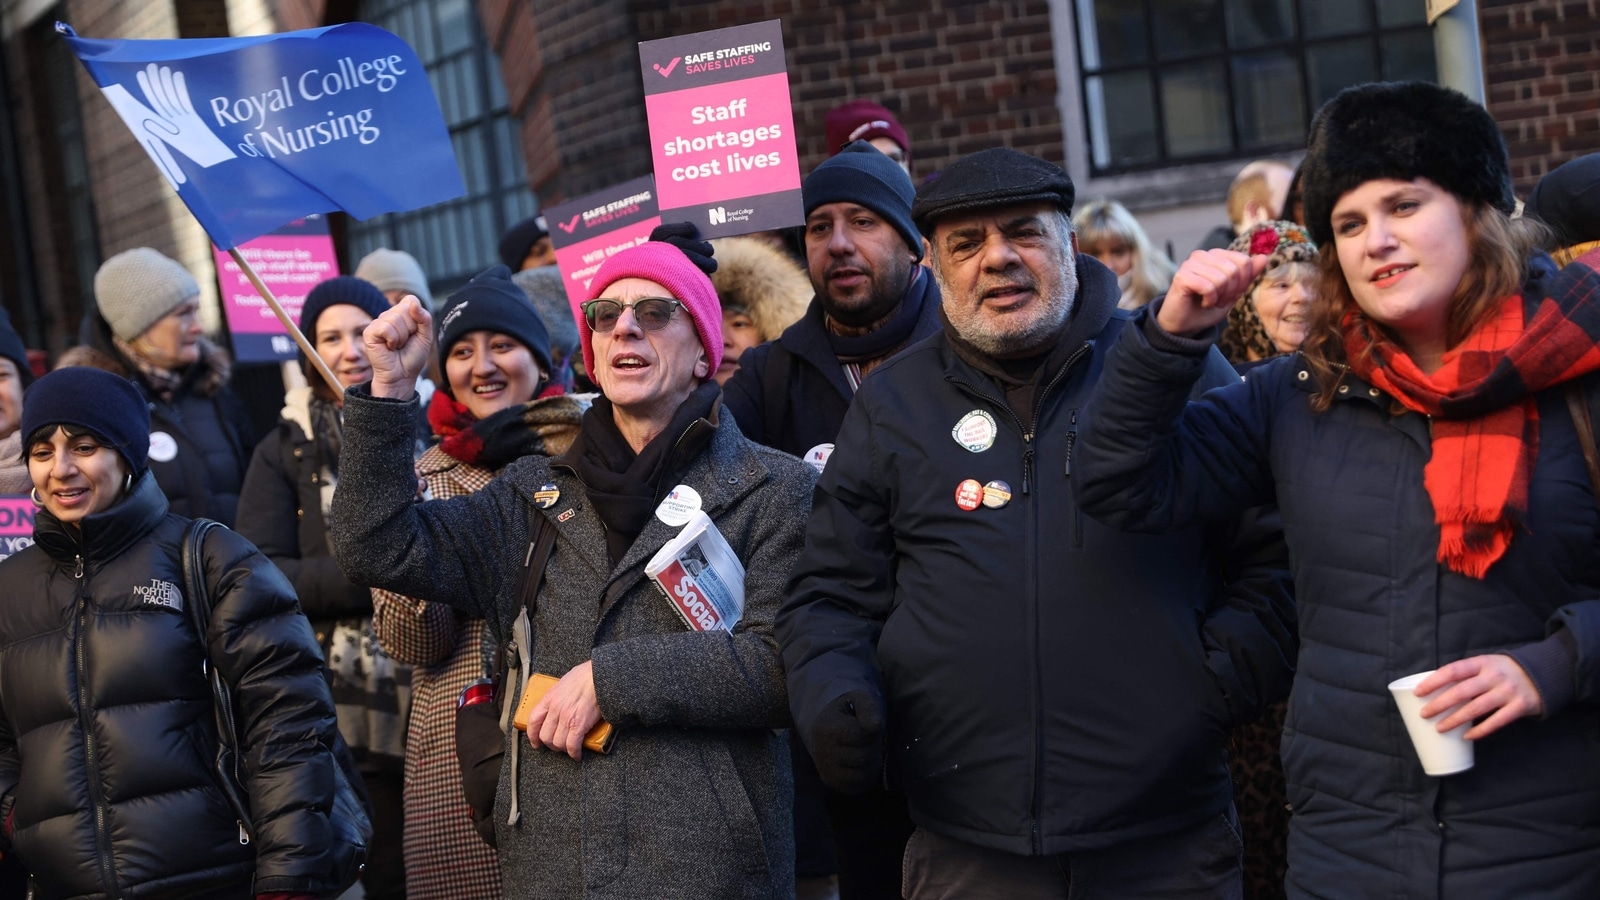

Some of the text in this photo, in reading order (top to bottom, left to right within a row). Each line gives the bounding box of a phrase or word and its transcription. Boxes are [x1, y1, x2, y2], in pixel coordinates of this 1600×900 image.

[685, 42, 771, 64] SAFE STAFFING
[686, 55, 754, 74] SAVES LIVES
[210, 54, 406, 129] Royal College
[691, 98, 747, 124] Staff
[238, 109, 380, 159] of Nursing
[664, 124, 782, 156] shortages
[672, 152, 780, 182] cost lives
[582, 191, 651, 220] SAFE STAFFING
[585, 204, 640, 228] SAVES LIVES
[582, 249, 604, 264] Will
[605, 242, 634, 256] there
[268, 260, 296, 271] staff
[298, 260, 330, 271] when
[5, 537, 36, 553] YO
[151, 579, 171, 590] THE
[705, 567, 718, 581] 1989
[134, 586, 170, 598] NORTH
[144, 595, 170, 606] FACE
[674, 575, 725, 630] Social
